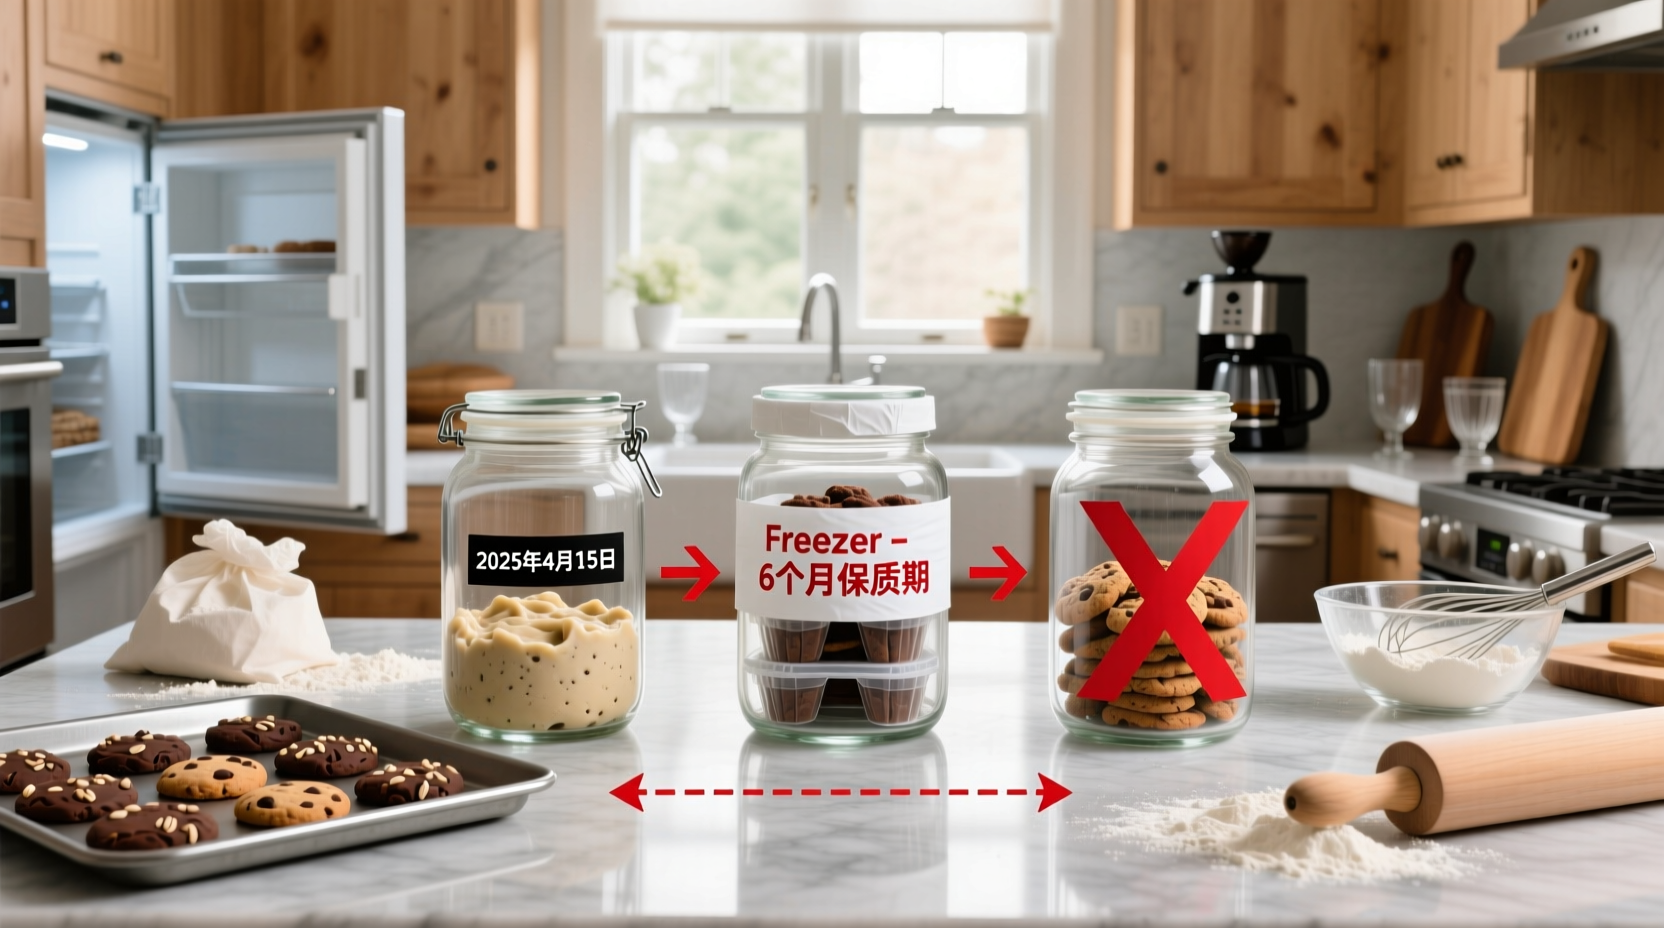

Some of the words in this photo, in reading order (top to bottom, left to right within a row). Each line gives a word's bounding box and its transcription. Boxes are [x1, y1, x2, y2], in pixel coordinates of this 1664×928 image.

[766, 523, 882, 555] Freezer
[475, 547, 616, 573] 2025年4月15日
[758, 559, 930, 597] 6个月保质期
